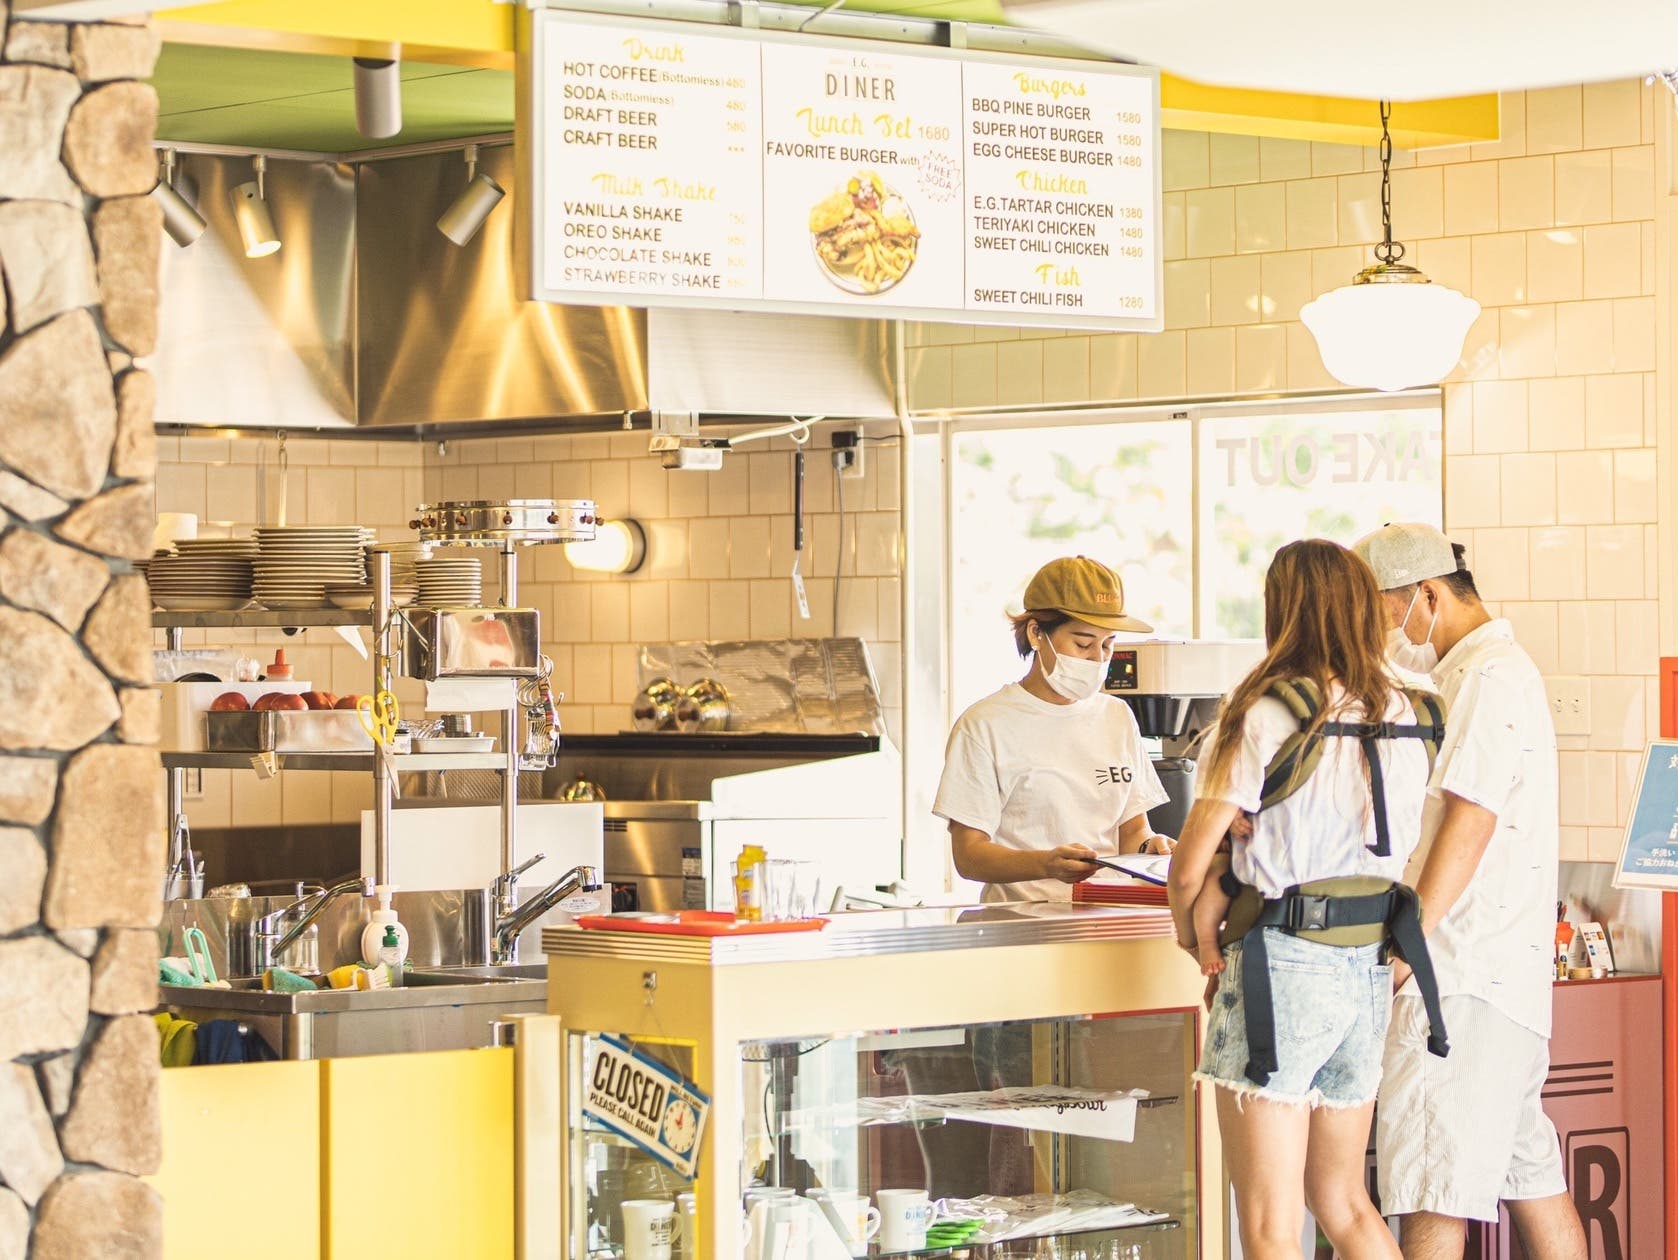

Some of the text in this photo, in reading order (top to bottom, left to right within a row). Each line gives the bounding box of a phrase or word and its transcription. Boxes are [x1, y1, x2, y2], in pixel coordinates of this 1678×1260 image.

[621, 37, 685, 62] Drink
[564, 62, 594, 77] HOT
[600, 65, 657, 82] COFFEE
[564, 86, 606, 101] SODA
[827, 73, 895, 100] DINER
[1014, 72, 1086, 99] Burgers
[564, 107, 657, 126] DRAFT BEER
[972, 99, 1090, 120] BBQ PINE BURGER
[1116, 112, 1141, 124] 1580
[796, 108, 863, 138] Lunch
[919, 126, 949, 140] 1680
[973, 122, 1103, 144] SUPER HOT BURGER
[564, 130, 657, 150] CRAFT BEER
[1117, 135, 1141, 146] 1580
[766, 142, 920, 166] FAVORITE BURGER with
[973, 143, 1113, 166] EGG CHEESE BURGER
[1118, 156, 1141, 167] 1480
[1016, 170, 1088, 194] Chicken
[564, 201, 683, 222] VANILLA SHAKE
[1056, 202, 1113, 218] CHICKEN
[564, 223, 662, 242] OREO SHAKE
[974, 216, 1095, 236] TERIYAKI CHICKEN
[1120, 228, 1142, 238] 1480
[564, 245, 657, 263] CHOCOLATE
[662, 251, 711, 266] SHAKE
[974, 236, 1109, 256] SWEET CHILI CHICKEN
[1121, 247, 1142, 257] 1480
[564, 267, 666, 286] STRAWBERRY
[672, 272, 720, 288] SHAKE
[1036, 264, 1081, 286] Fish
[974, 289, 1083, 307] SWEET CHILI FISH
[594, 1051, 665, 1122] CLOSED
[591, 1093, 656, 1138] PLEASE CALL AGAIN
